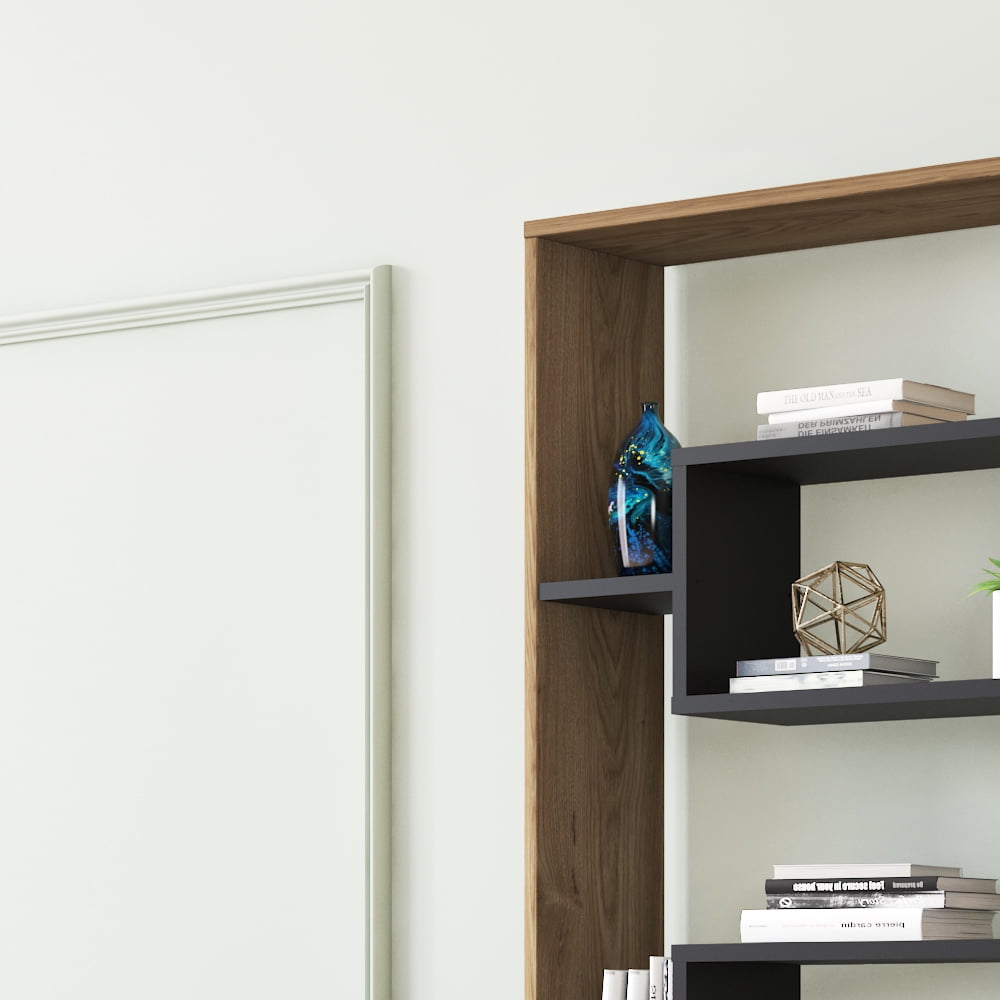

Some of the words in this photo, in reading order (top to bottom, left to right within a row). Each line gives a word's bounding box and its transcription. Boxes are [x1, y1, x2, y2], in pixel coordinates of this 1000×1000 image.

[784, 395, 799, 405] THE
[800, 393, 817, 403] OLD
[817, 391, 835, 402] MAN
[857, 386, 872, 398] SEA
